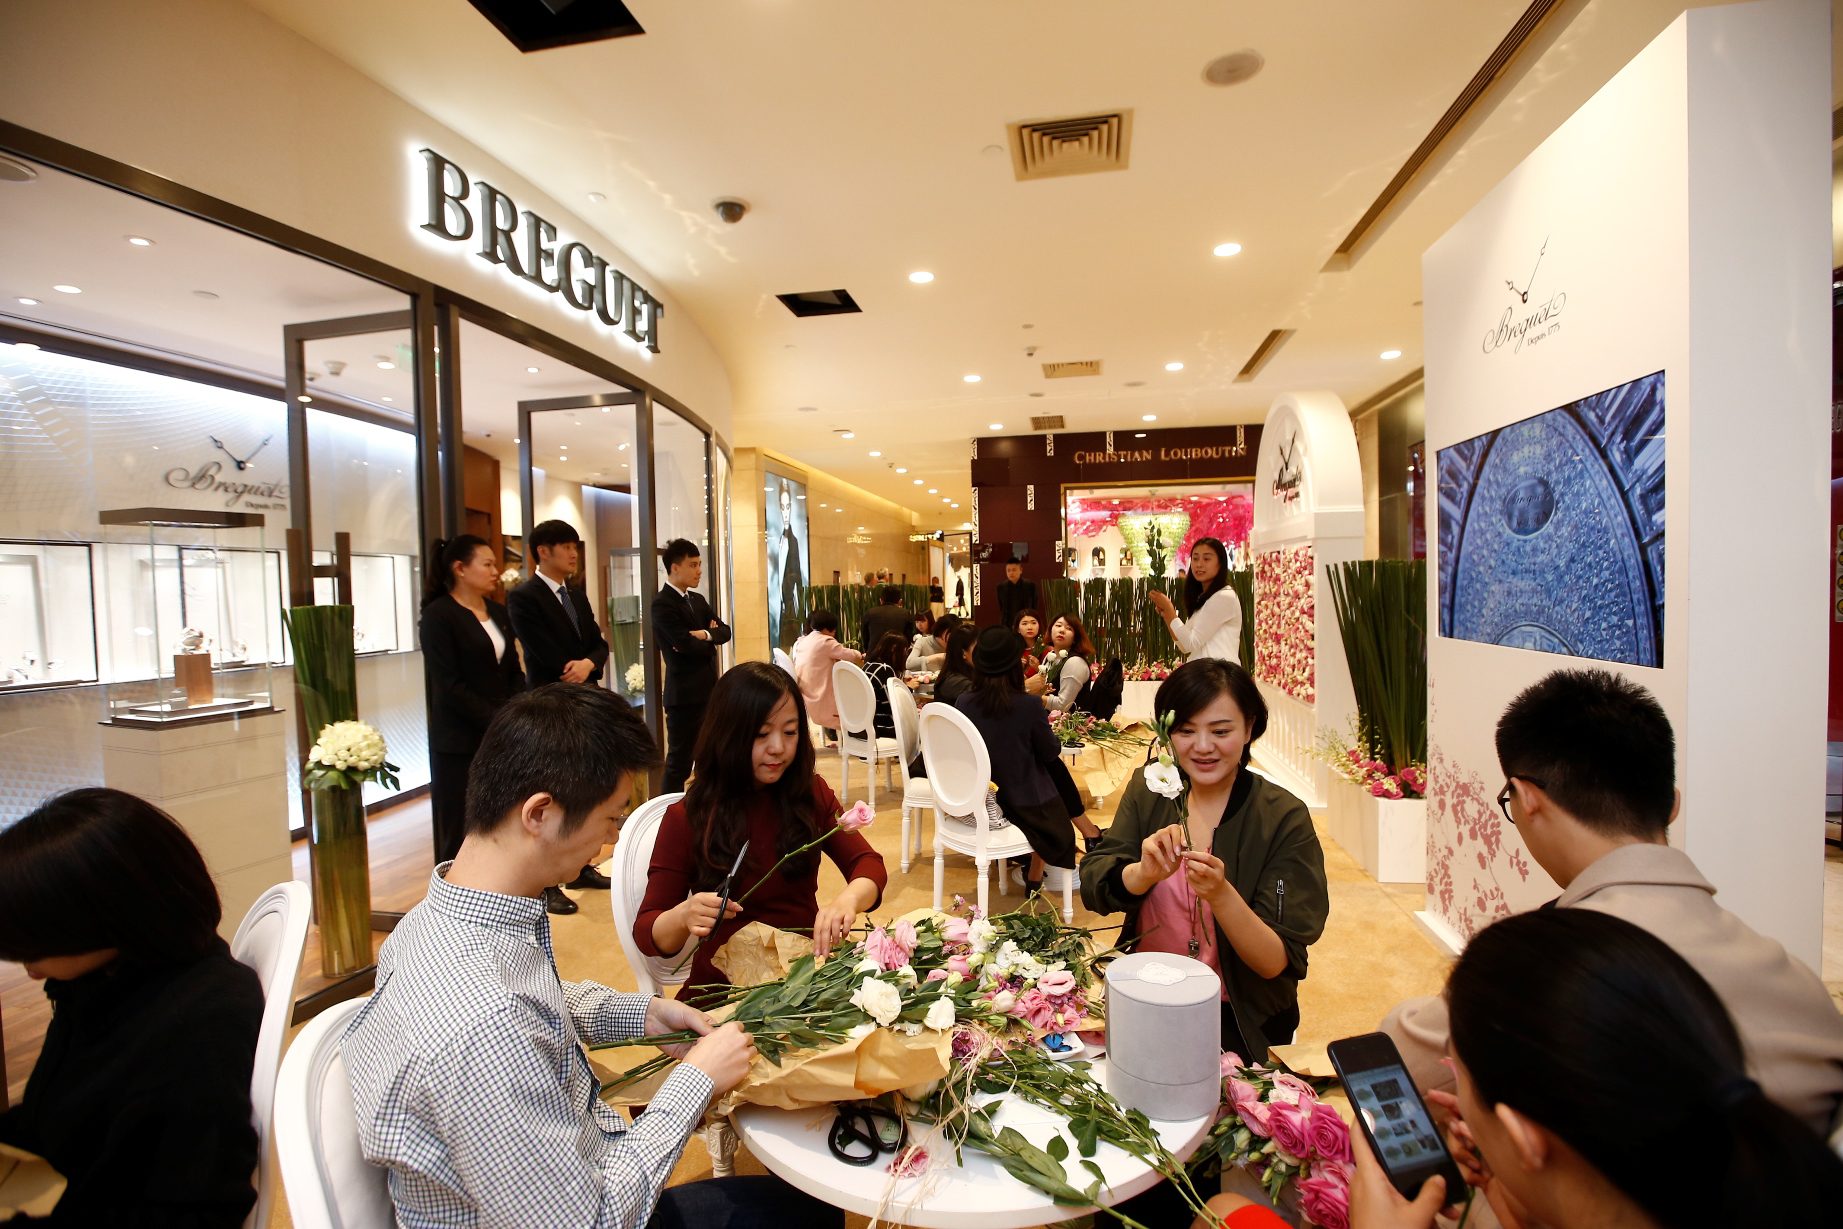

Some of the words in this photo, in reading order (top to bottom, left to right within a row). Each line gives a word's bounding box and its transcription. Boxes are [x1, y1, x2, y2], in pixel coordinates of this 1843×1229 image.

[419, 148, 664, 354] BREGUET
[1482, 289, 1566, 354] Breguet
[165, 461, 288, 507] Breguet
[1074, 449, 1151, 464] CHRISTIAN
